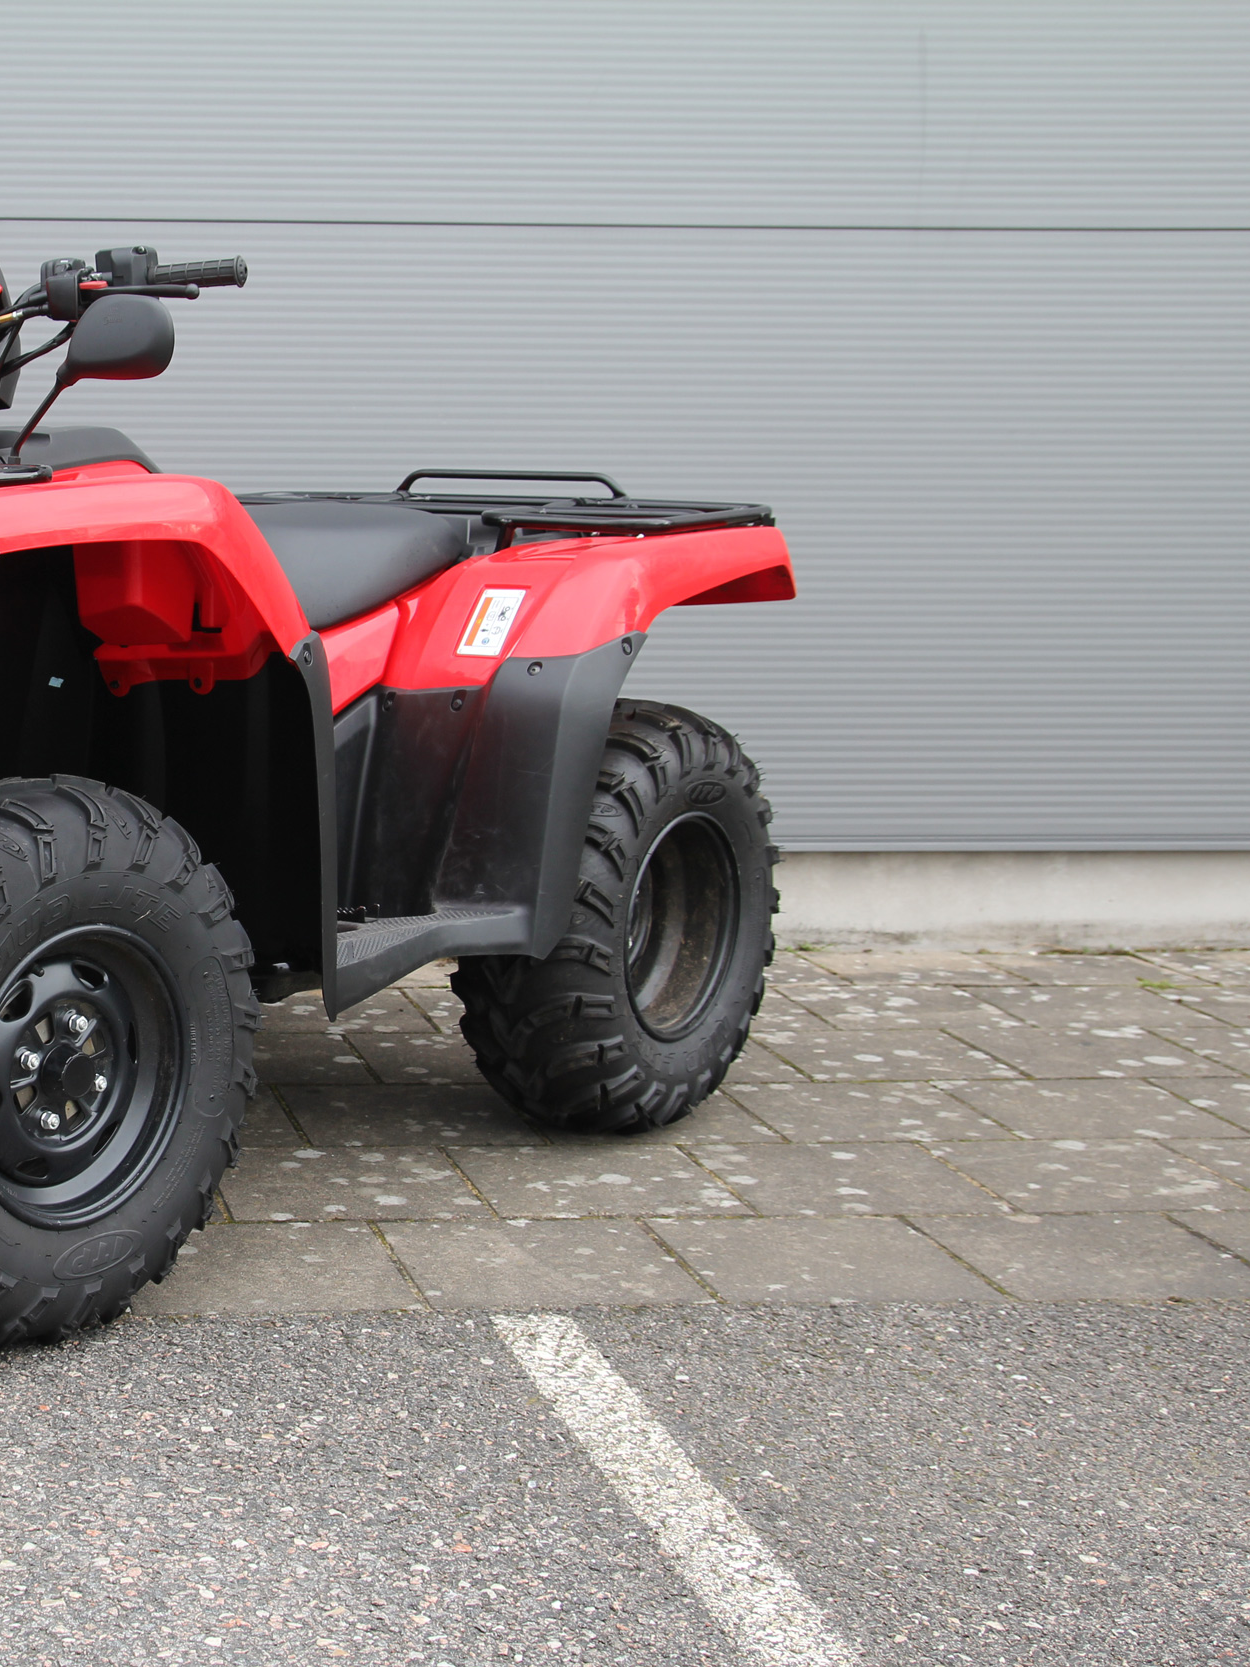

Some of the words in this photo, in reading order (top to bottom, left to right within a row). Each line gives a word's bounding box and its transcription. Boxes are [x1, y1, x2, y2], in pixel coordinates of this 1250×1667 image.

[690, 785, 723, 800] ITP
[89, 883, 183, 933] LITE
[71, 1235, 126, 1275] ITP
